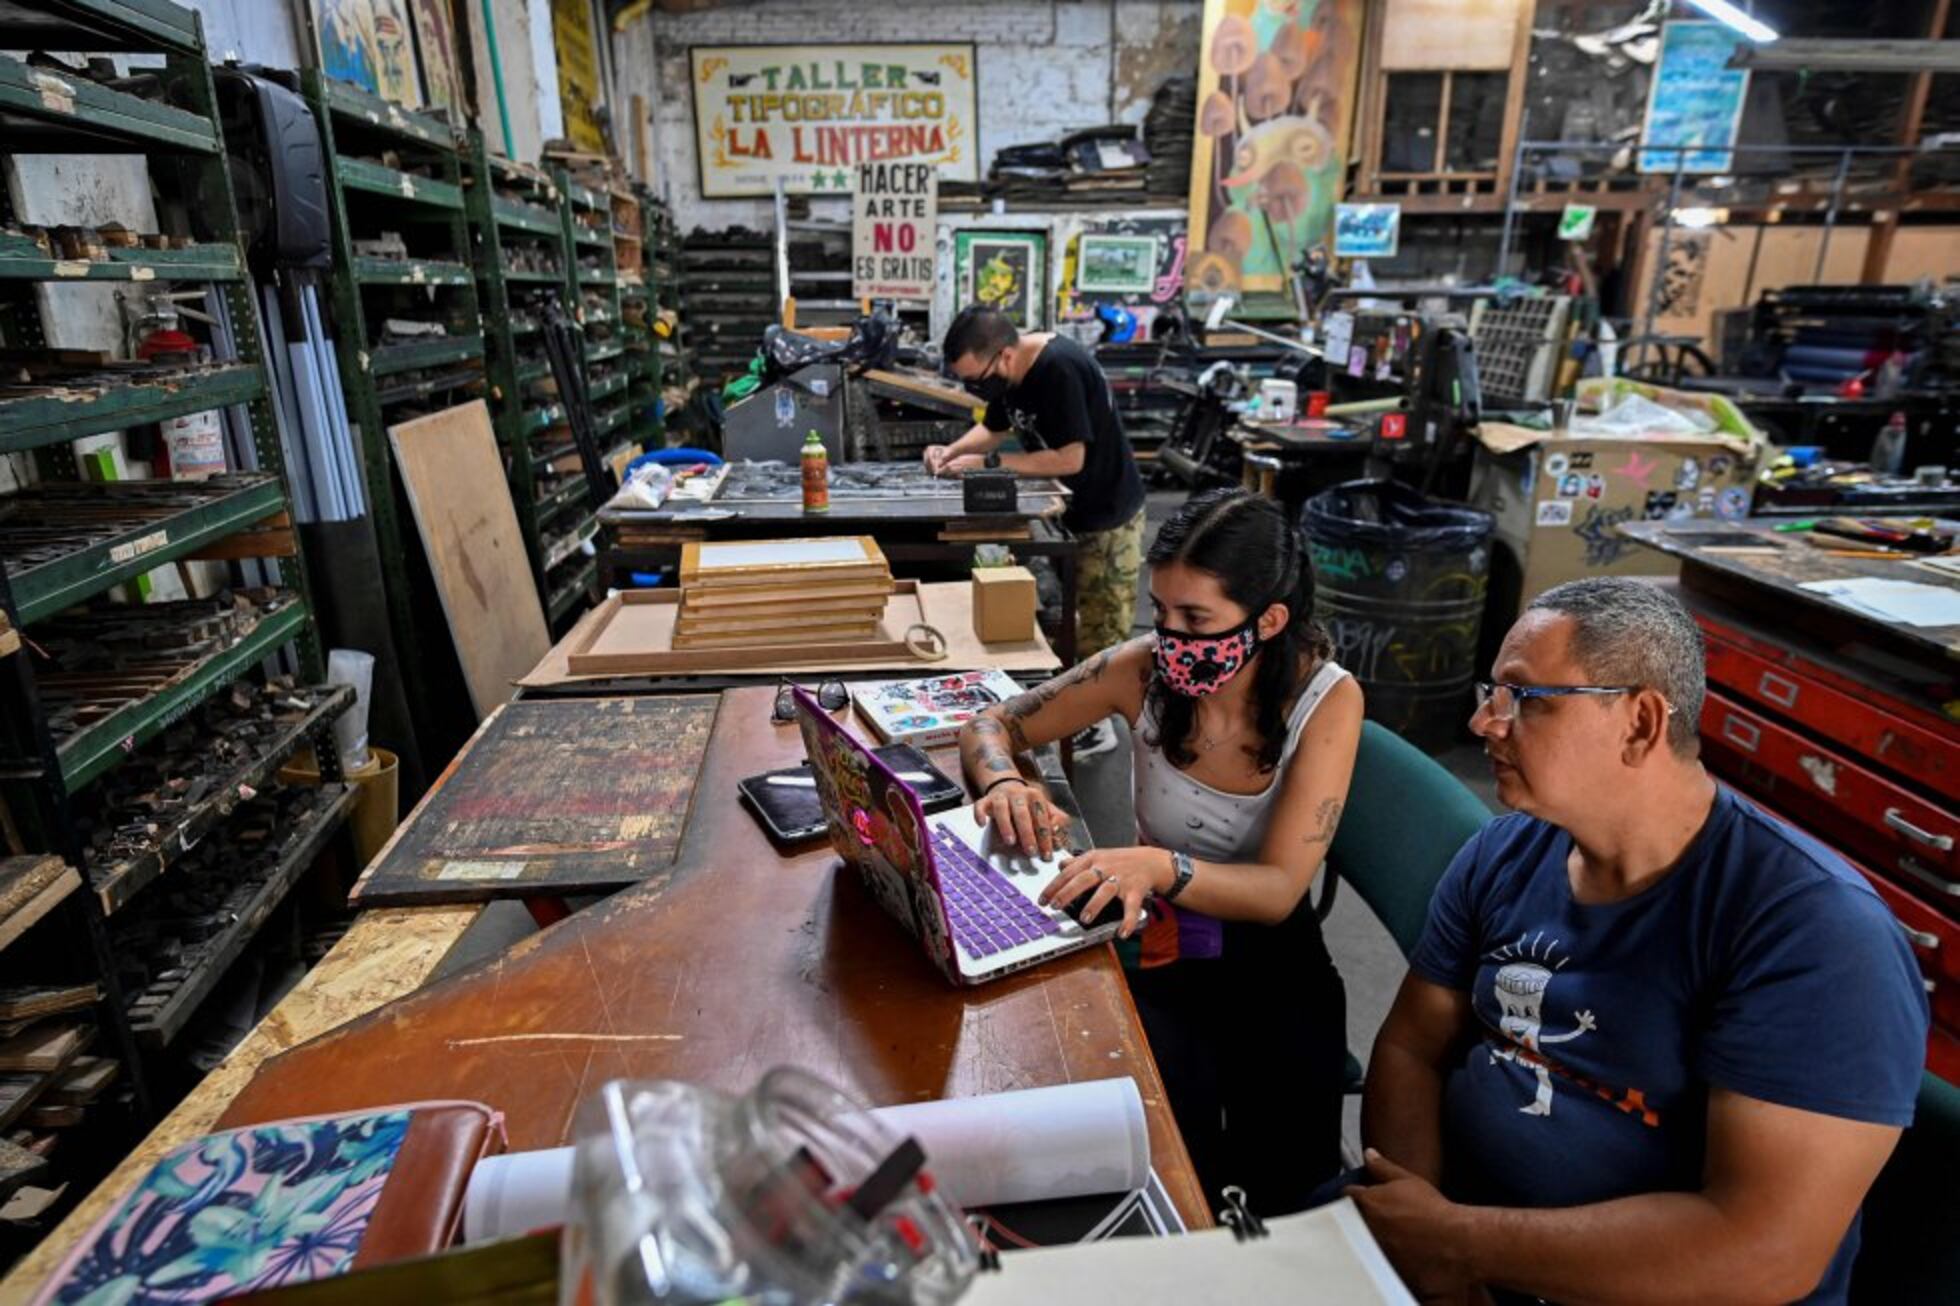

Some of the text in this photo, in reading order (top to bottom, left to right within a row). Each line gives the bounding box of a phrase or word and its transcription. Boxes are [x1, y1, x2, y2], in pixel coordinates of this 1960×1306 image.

[761, 60, 907, 90] TALLER
[726, 87, 944, 122] TIPOGRÁFICO
[728, 125, 945, 167] LA LINTERNA
[866, 198, 925, 217] ARTE
[874, 222, 914, 253] NO
[856, 256, 932, 281] ES GRATIS
